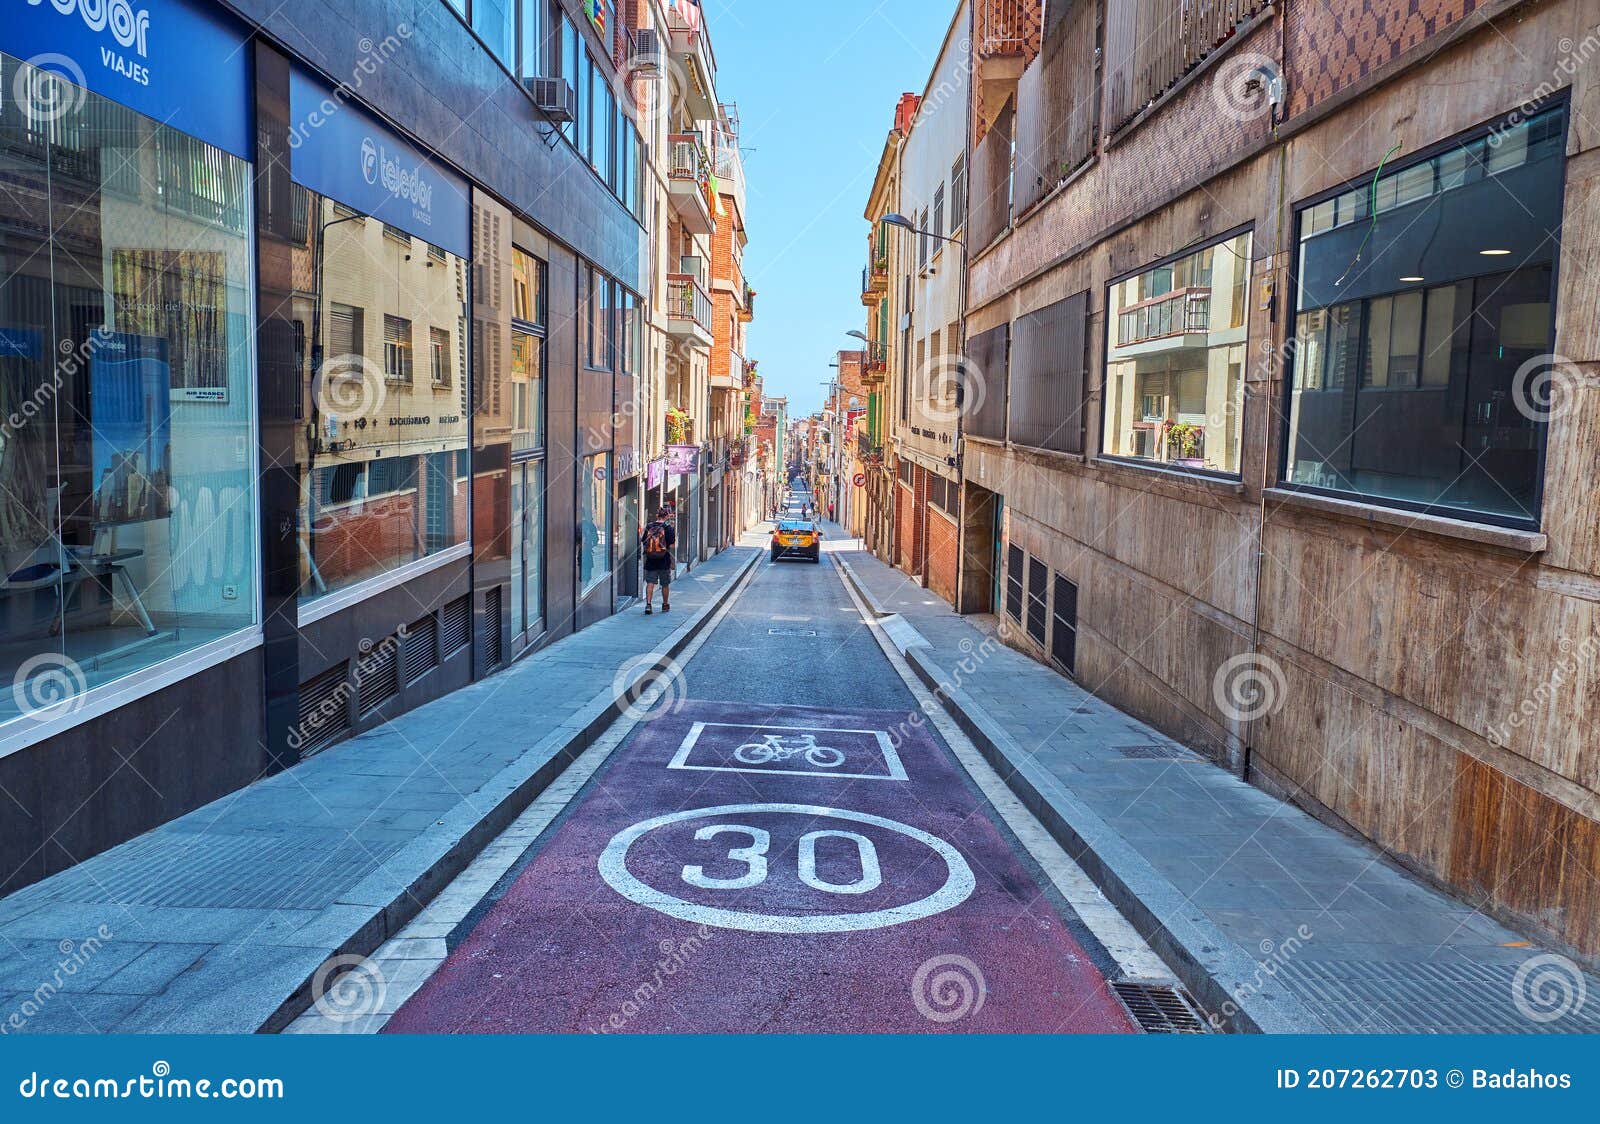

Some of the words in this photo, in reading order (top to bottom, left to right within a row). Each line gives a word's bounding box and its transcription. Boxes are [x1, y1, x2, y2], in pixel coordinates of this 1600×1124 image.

[100, 46, 149, 86] VIAJES
[380, 144, 433, 213] tejedor
[681, 824, 882, 894] 30
